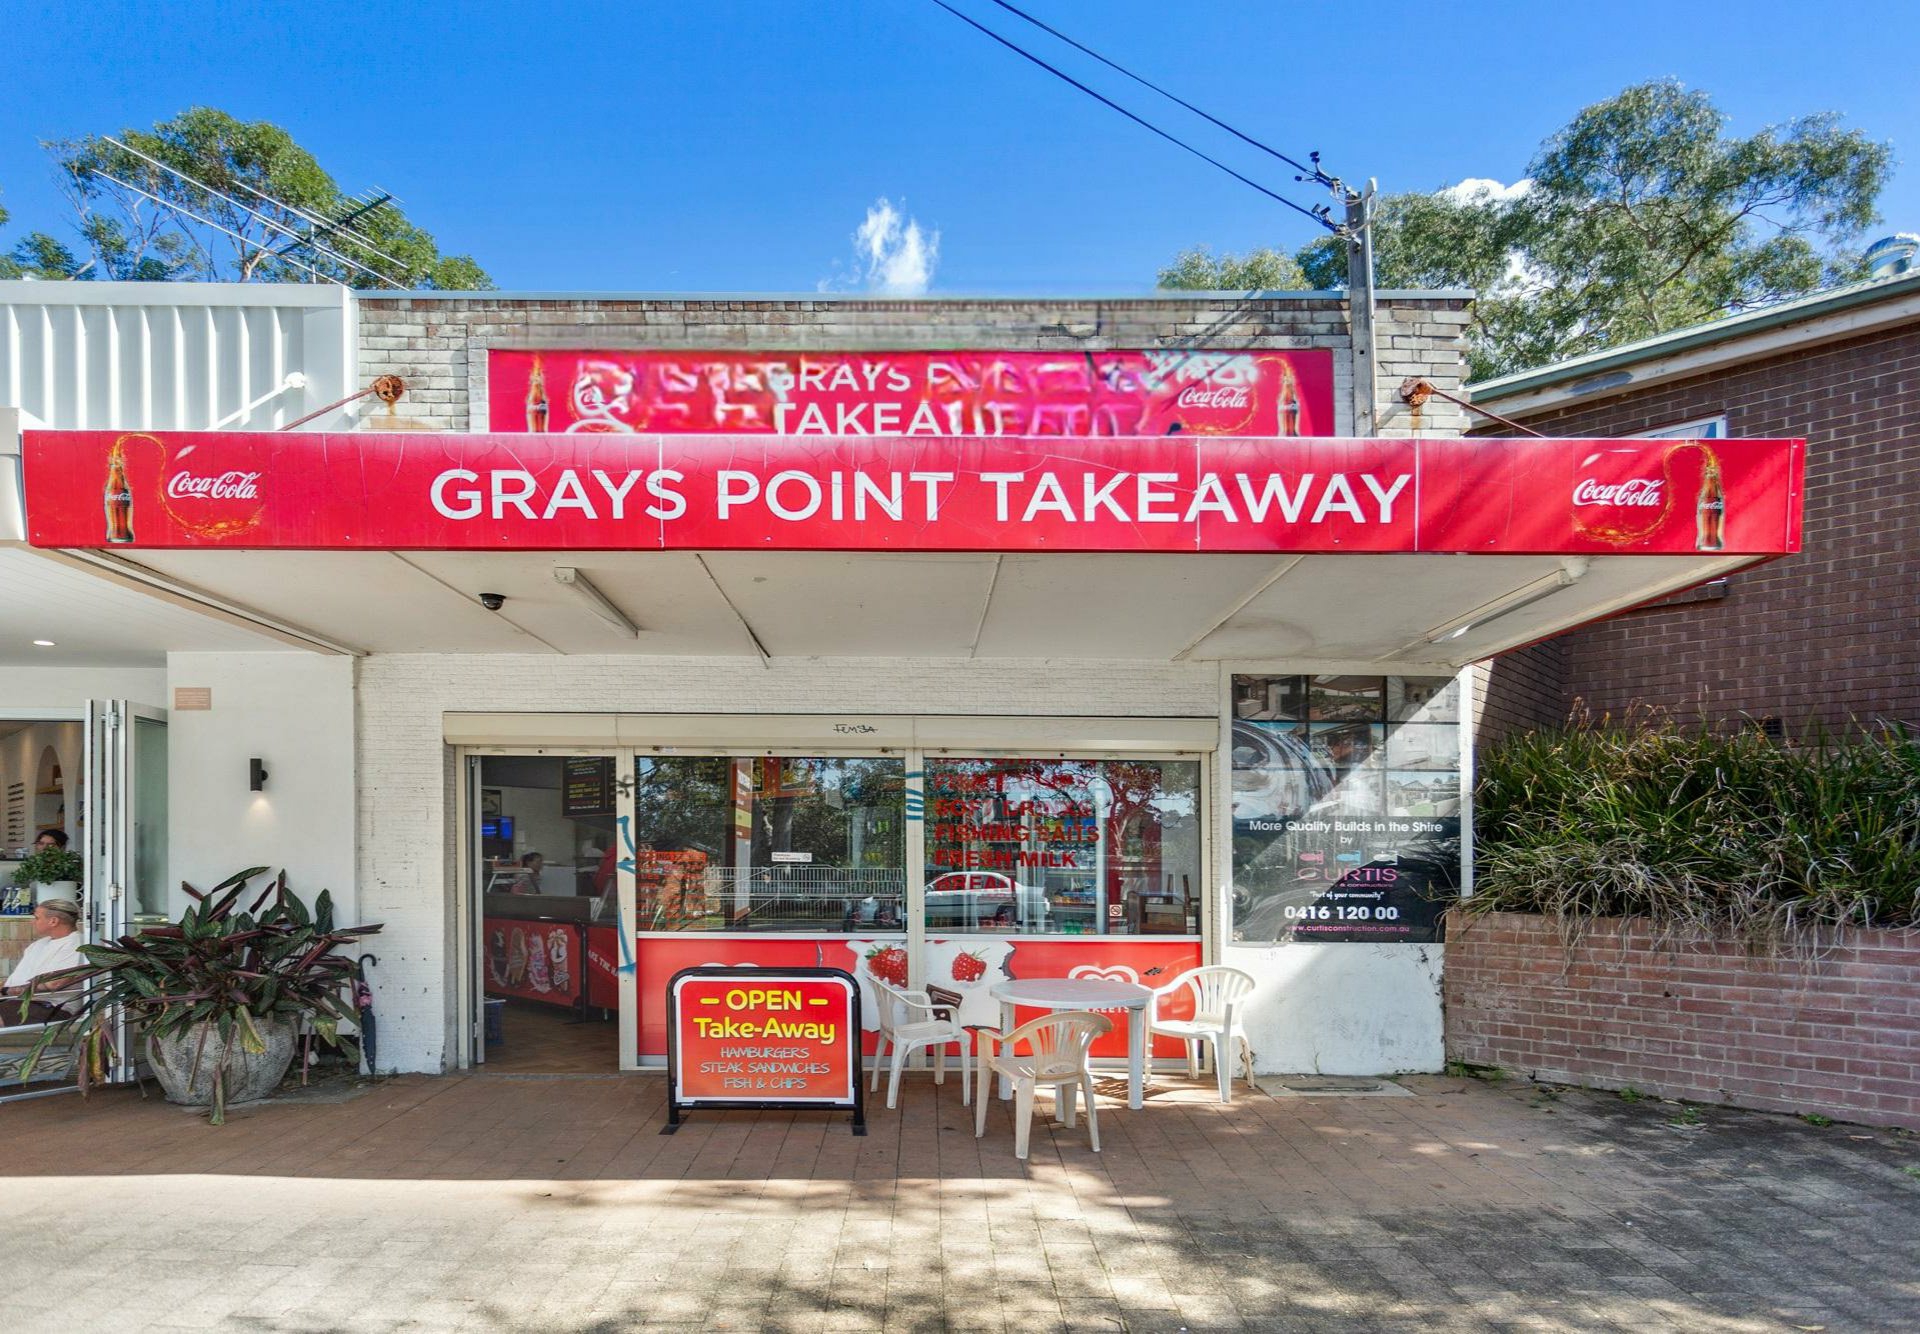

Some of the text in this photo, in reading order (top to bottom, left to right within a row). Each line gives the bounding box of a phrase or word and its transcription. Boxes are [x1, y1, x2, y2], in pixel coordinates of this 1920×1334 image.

[767, 362, 911, 391] GRAYS
[167, 470, 263, 499] Coca-Cola
[1572, 478, 1666, 507] Coca-Cola
[430, 468, 1412, 523] GRAYS POINT TAKEAWAY
[934, 823, 1100, 843] FISHING BAITS
[1249, 820, 1443, 835] More Quality Builds in the Shire
[1340, 835, 1353, 845] by
[934, 849, 1078, 868] FRESH MILK
[1297, 866, 1398, 882] CURTIS
[1284, 905, 1331, 920] 0416
[1336, 906, 1370, 920] 120
[726, 989, 802, 1011] OPEN
[693, 1017, 836, 1045] Take-Away
[720, 1047, 810, 1059] HAMBURGERS
[700, 1061, 831, 1074] STEAK SANDWICHES
[724, 1077, 808, 1089] FISH & CHIPS
